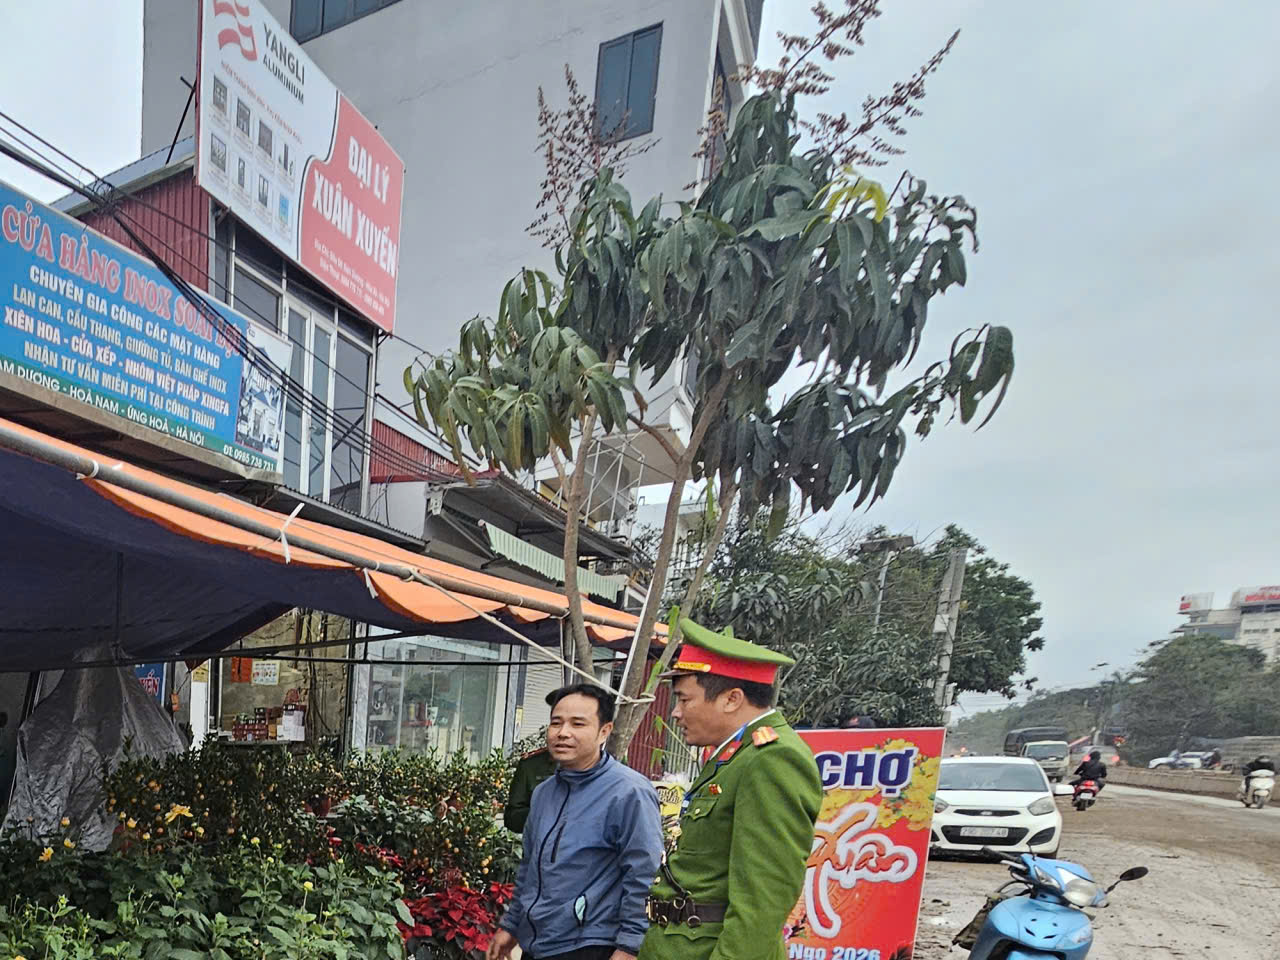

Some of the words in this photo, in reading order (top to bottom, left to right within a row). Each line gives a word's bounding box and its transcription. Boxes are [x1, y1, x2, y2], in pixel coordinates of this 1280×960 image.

[263, 22, 305, 86] YANGLI
[263, 53, 304, 105] ALUMINIUM
[349, 135, 372, 190] ĐẠI
[374, 163, 389, 205] LÝ
[1, 200, 55, 263] CỬA
[59, 233, 121, 294] HÀNG
[124, 268, 173, 320] INOX
[312, 168, 353, 240] XUÂN
[355, 207, 397, 278] XUYẾN
[4, 306, 34, 334] XIÊN
[37, 320, 61, 345] HOA
[71, 333, 93, 359] CỬA
[95, 346, 117, 367] XẾP
[125, 358, 154, 384] NHÔM
[156, 373, 175, 394] VIỆT
[176, 380, 200, 402] PHÁP
[201, 391, 230, 417] XINGFA
[13, 284, 36, 309] LAN
[38, 296, 64, 322] CAN,
[89, 318, 123, 350] THANG,
[174, 358, 192, 378] BÀN
[193, 367, 209, 386] GHẾ
[209, 375, 228, 394] INOX
[29, 265, 84, 305] CHUYÊN
[86, 293, 108, 316] GIA
[110, 303, 143, 332] CÔNG
[145, 318, 168, 344] CÁC
[194, 344, 220, 371] HÀNG
[17, 364, 61, 392] DƯƠNG
[95, 394, 120, 415] NAM
[176, 424, 189, 441] HÀ
[24, 341, 58, 369] NHẬN
[61, 355, 77, 374] TƯ
[77, 361, 99, 385] VẤN
[101, 371, 128, 398] MIỄN
[130, 383, 148, 403] PHÍ
[149, 391, 164, 411] TẠI
[165, 398, 190, 420] CÔNG
[191, 408, 216, 431] TRÌNH
[814, 748, 919, 797] CHỢ
